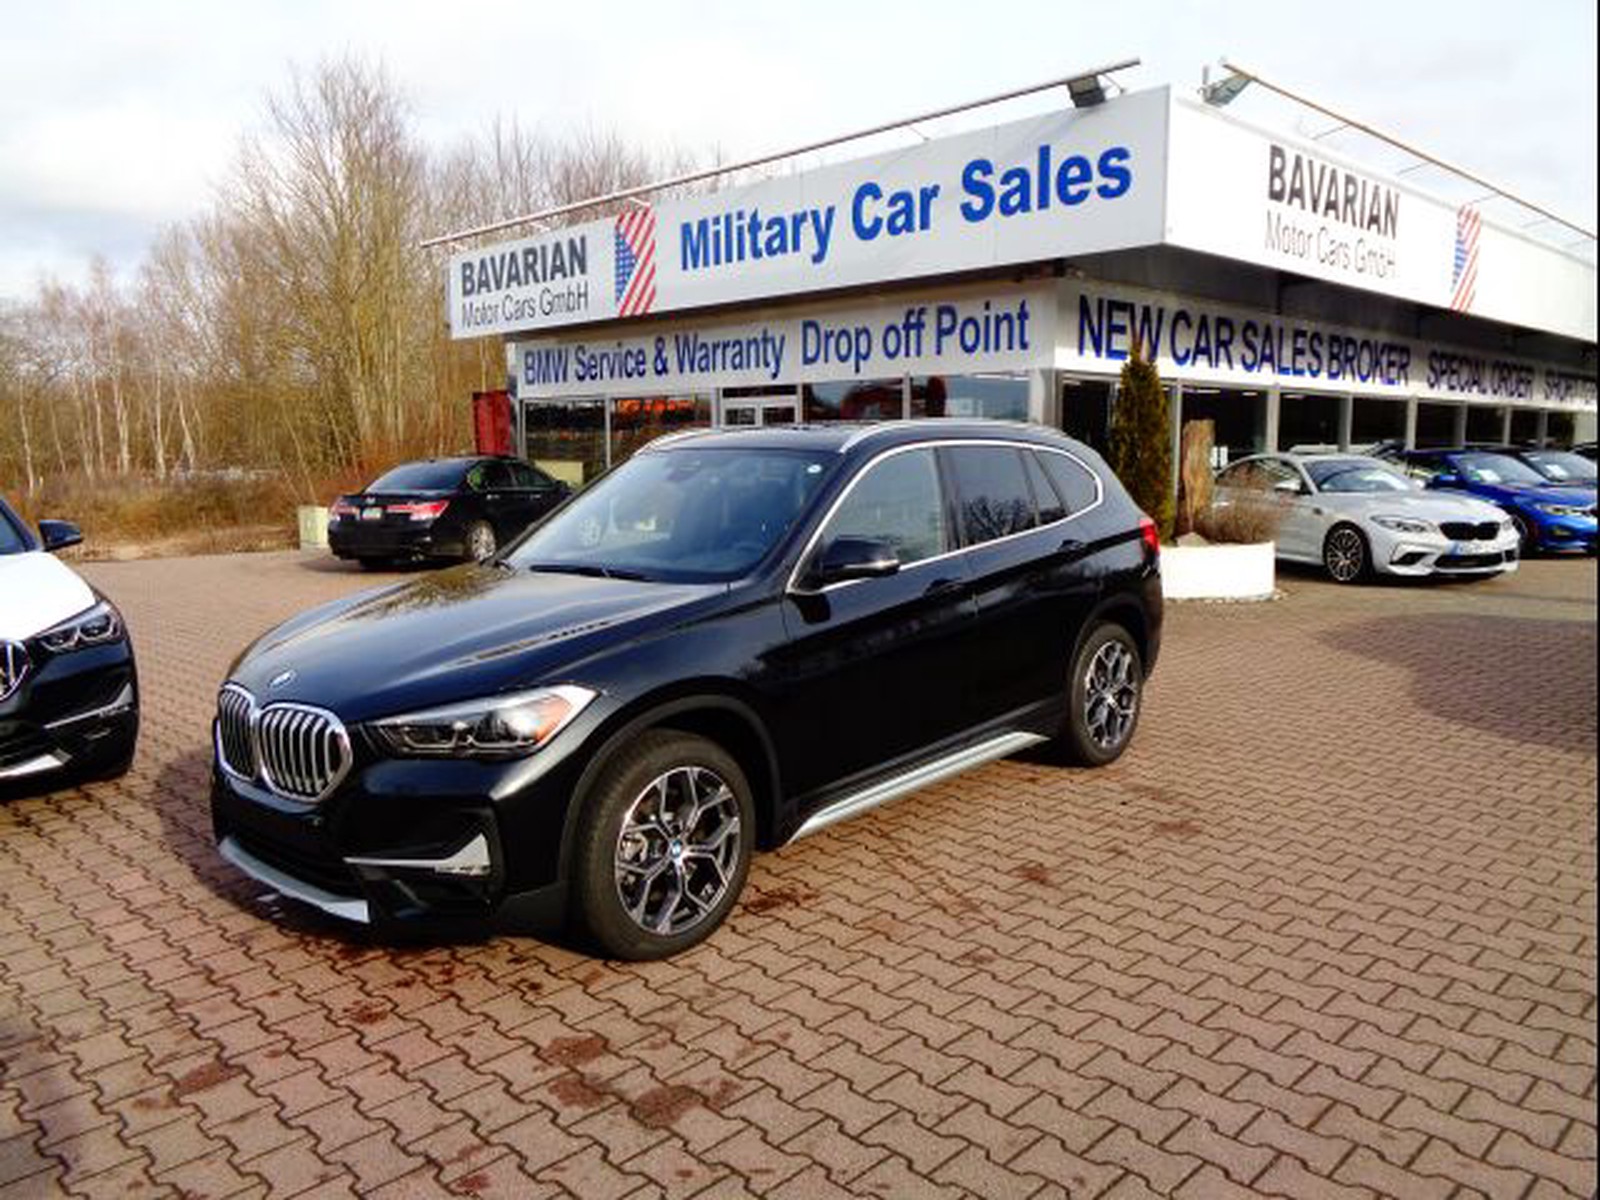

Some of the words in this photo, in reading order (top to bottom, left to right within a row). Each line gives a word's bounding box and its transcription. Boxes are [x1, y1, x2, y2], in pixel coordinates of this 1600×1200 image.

[680, 205, 836, 271] Military
[852, 182, 941, 241] Car
[960, 144, 1132, 223] Sales
[1264, 209, 1313, 260] Motor
[1268, 144, 1400, 240] BAVARIAN
[461, 236, 587, 297] BAVARIAN
[461, 300, 499, 328] Motor
[502, 293, 536, 321] Cars
[540, 279, 589, 316] GmbH
[524, 347, 568, 386] BMW
[574, 341, 647, 382] Service
[653, 336, 669, 376] &
[674, 328, 785, 379] Warranty
[802, 319, 872, 373] Drop
[882, 306, 927, 359] off
[935, 299, 1030, 356] Point
[1078, 294, 1165, 363] NEW
[1170, 309, 1234, 371] CAR
[1240, 320, 1324, 379] SALES
[1327, 333, 1412, 387] BROKER
[1427, 350, 1488, 396] SPECIAL
